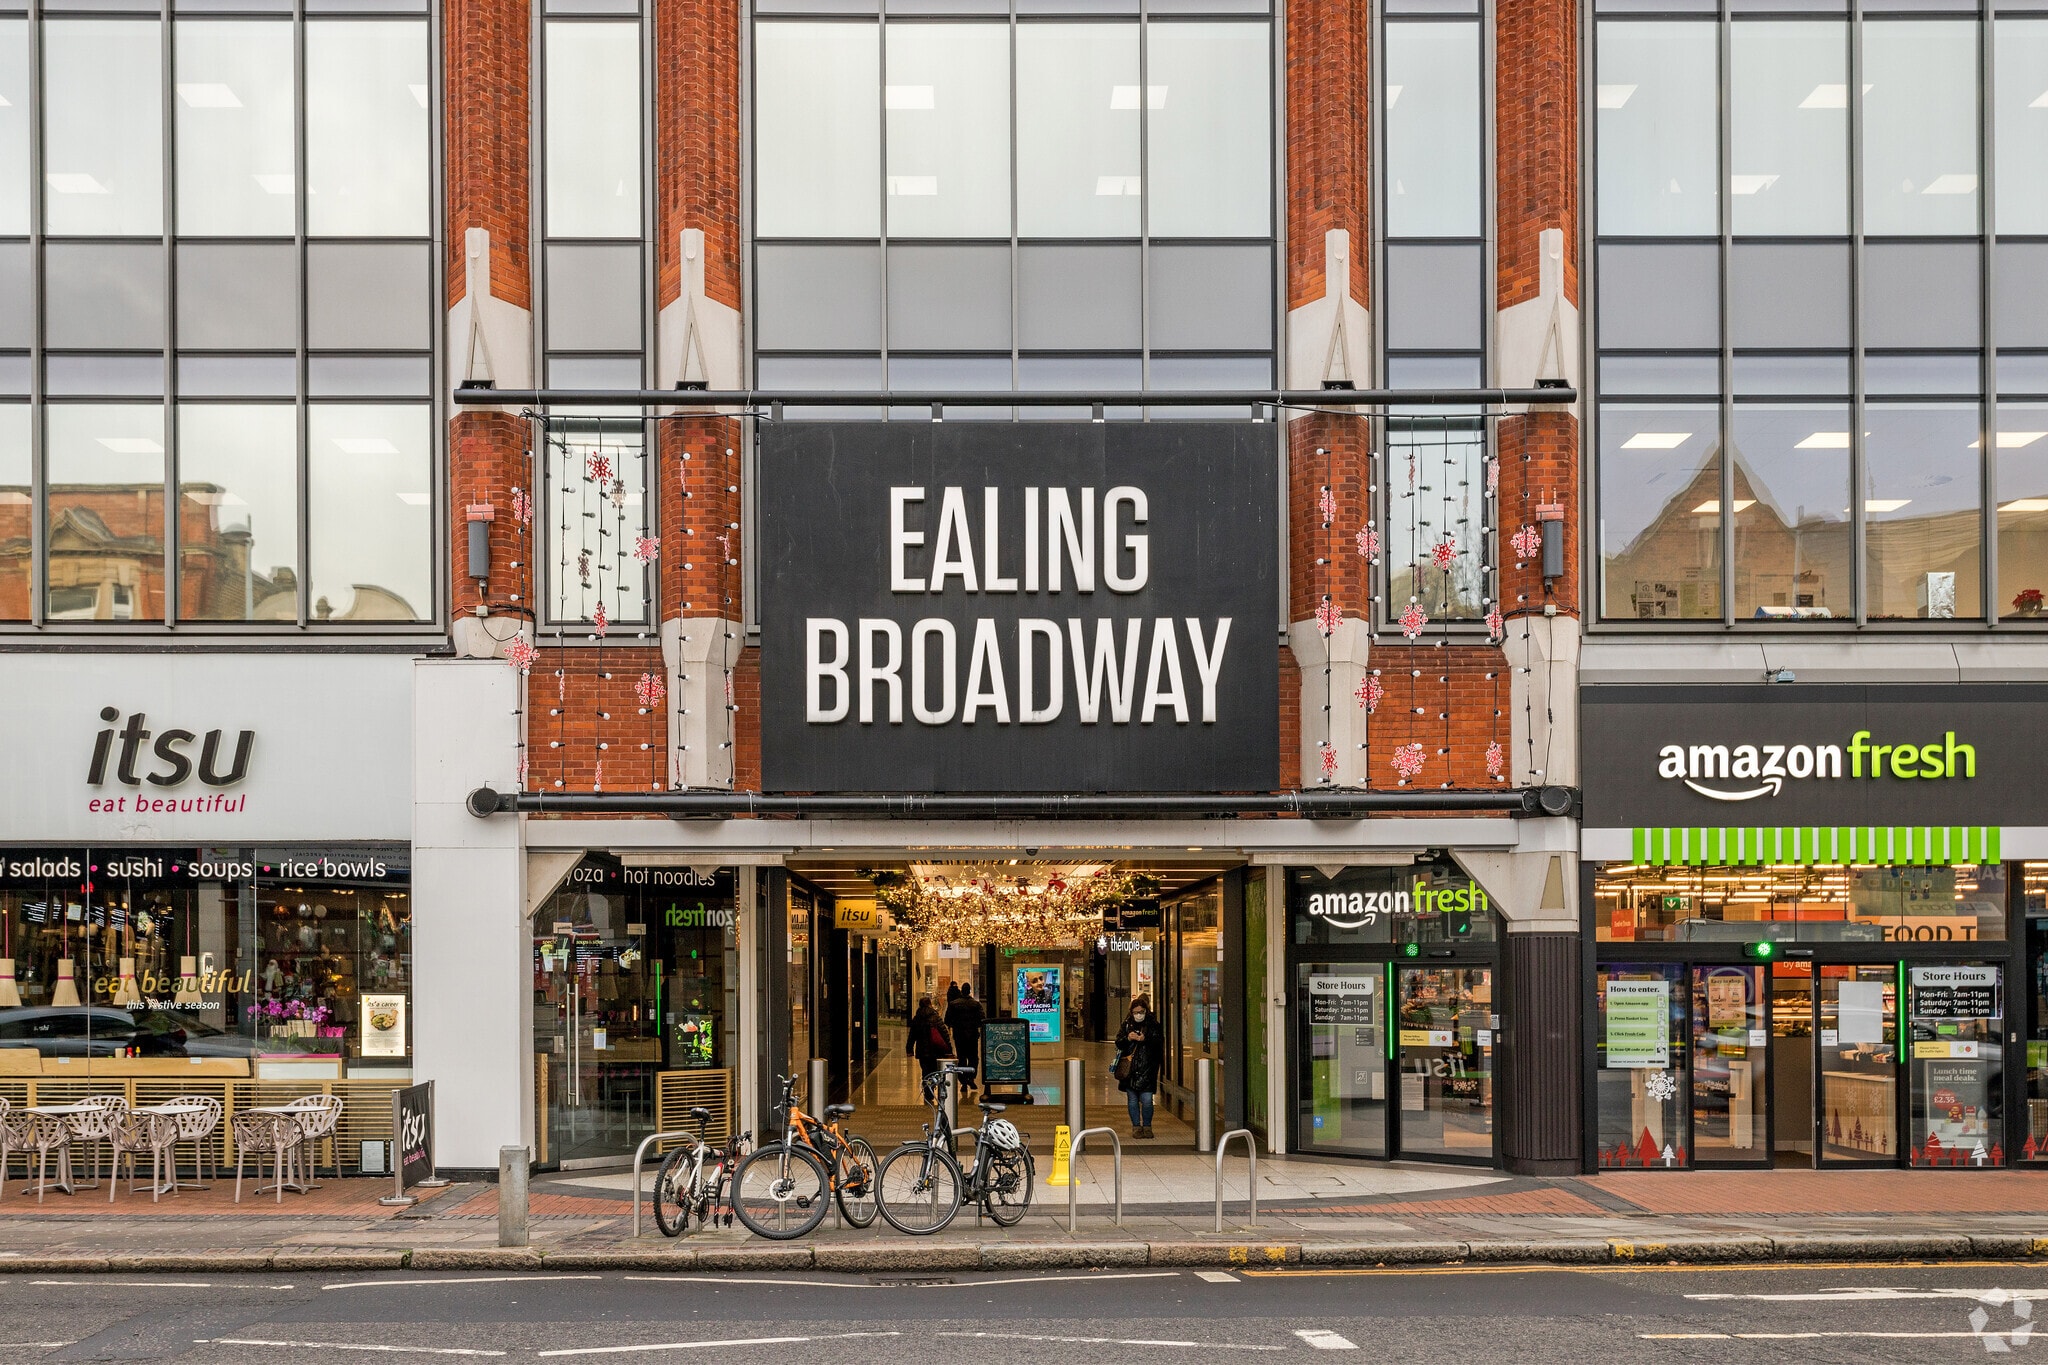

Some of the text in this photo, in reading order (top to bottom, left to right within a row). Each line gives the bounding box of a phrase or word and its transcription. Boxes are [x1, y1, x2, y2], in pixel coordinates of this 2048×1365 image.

[890, 485, 1149, 594] EALING
[806, 617, 1233, 725] BROADWAY
[87, 706, 256, 786] itsu
[1658, 730, 1976, 780] amazon fresh
[88, 794, 246, 813] eat beautiful
[9, 856, 81, 878] salads
[106, 856, 162, 878] sushi
[188, 862, 253, 882] soups
[280, 858, 318, 878] rice
[324, 857, 386, 878] bowls
[624, 866, 649, 884] hot
[654, 866, 716, 886] noodles
[1308, 880, 1488, 915] amazon fresh
[842, 907, 870, 922] itsu
[1882, 926, 1953, 942] FOOD
[1110, 936, 1140, 956] thérapie
[1784, 962, 1794, 970] by
[1922, 972, 1986, 980] Store Hours
[94, 968, 252, 994] eat beautiful
[1317, 981, 1366, 990] Store Hours
[126, 1000, 145, 1010] this
[184, 1002, 220, 1010] season
[402, 1107, 425, 1152] itsu
